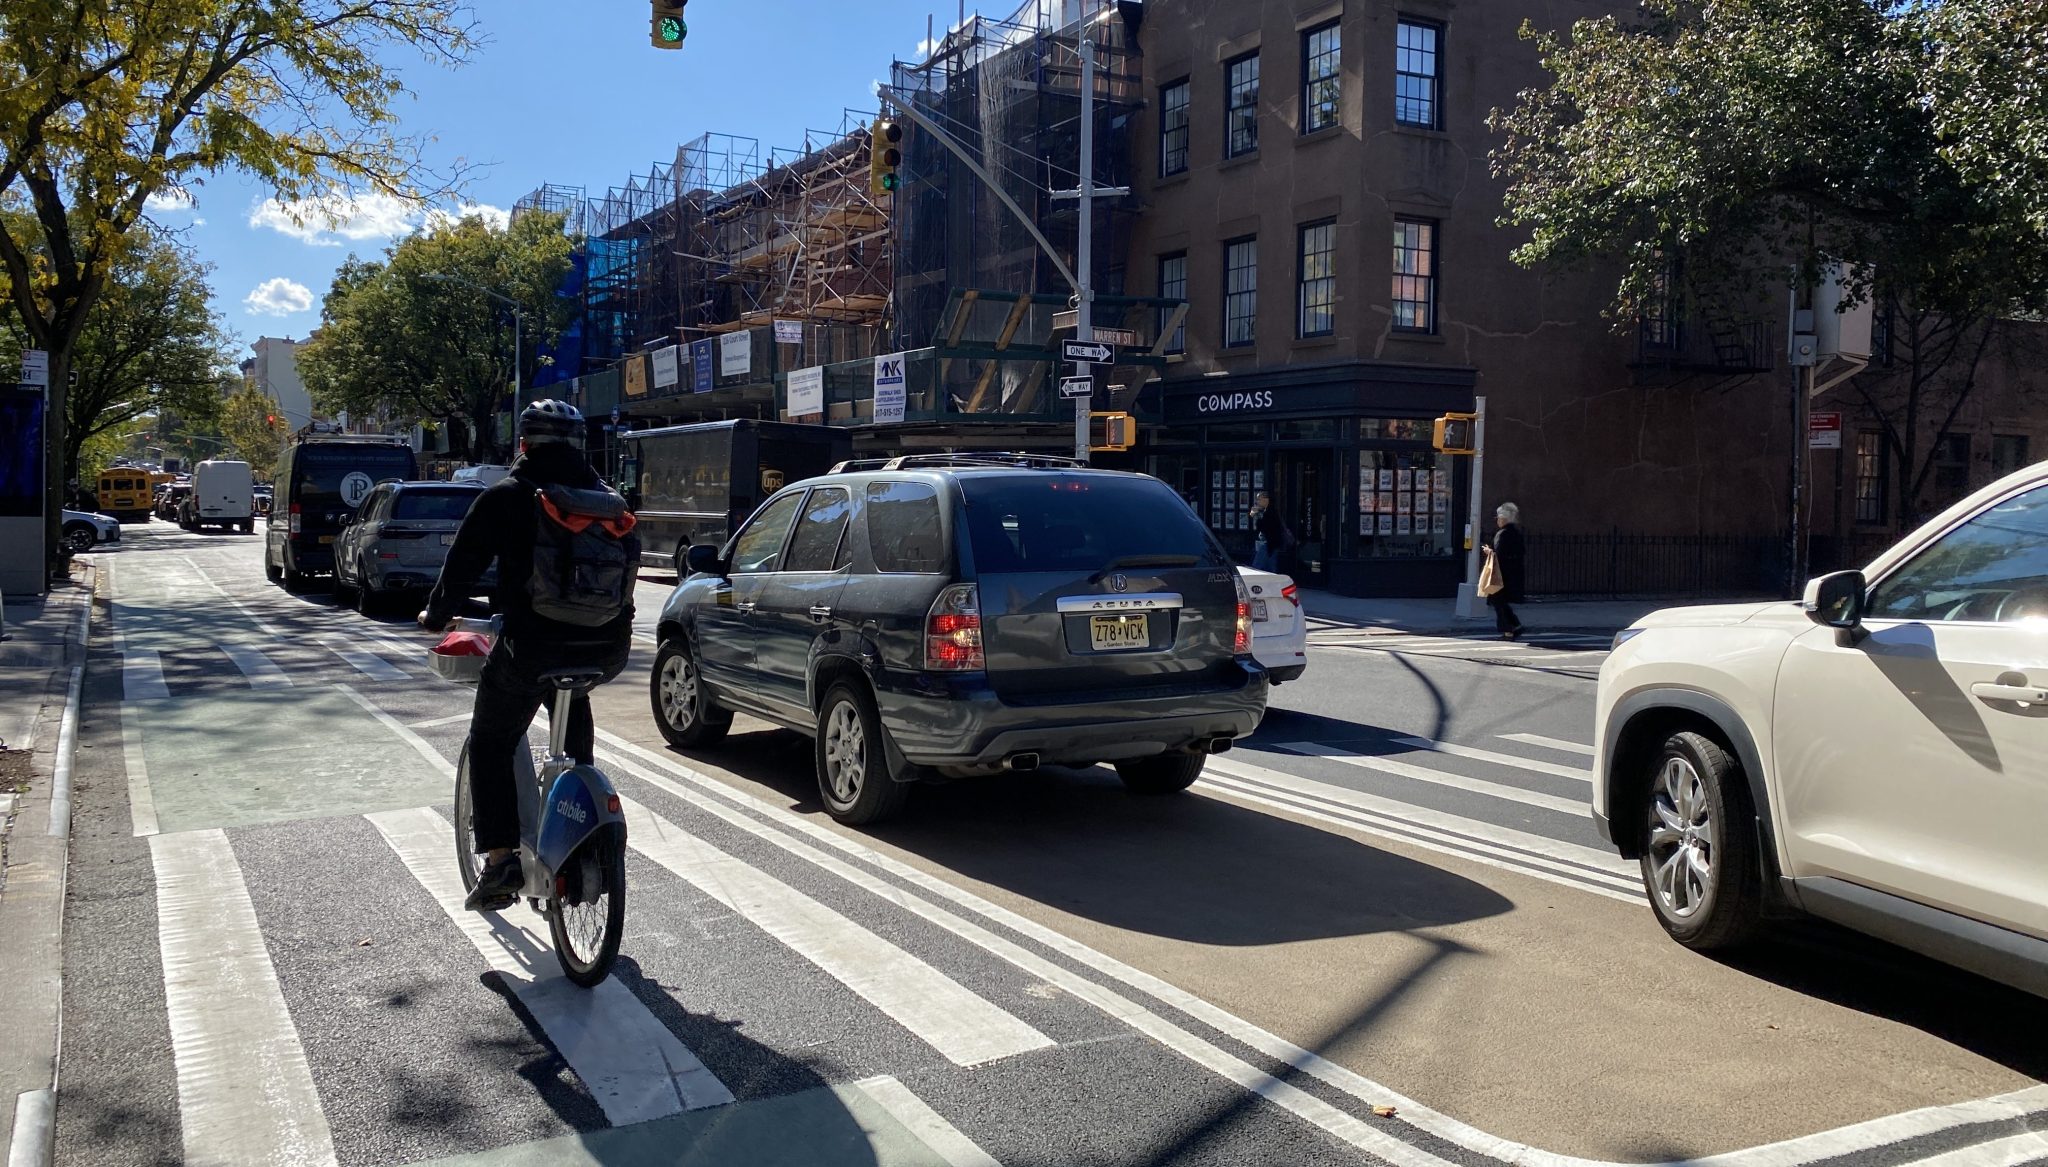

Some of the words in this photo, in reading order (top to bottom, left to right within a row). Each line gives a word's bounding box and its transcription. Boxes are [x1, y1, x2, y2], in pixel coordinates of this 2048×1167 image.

[1094, 330, 1121, 344] WARREN
[1124, 333, 1131, 344] ST
[1070, 346, 1086, 356] ONE
[1065, 384, 1075, 392] ONE
[1078, 383, 1089, 391] WAY
[1198, 390, 1273, 412] COMPASS
[763, 477, 782, 492] ups
[1207, 573, 1230, 583] MDX
[1092, 600, 1156, 609] ACURA
